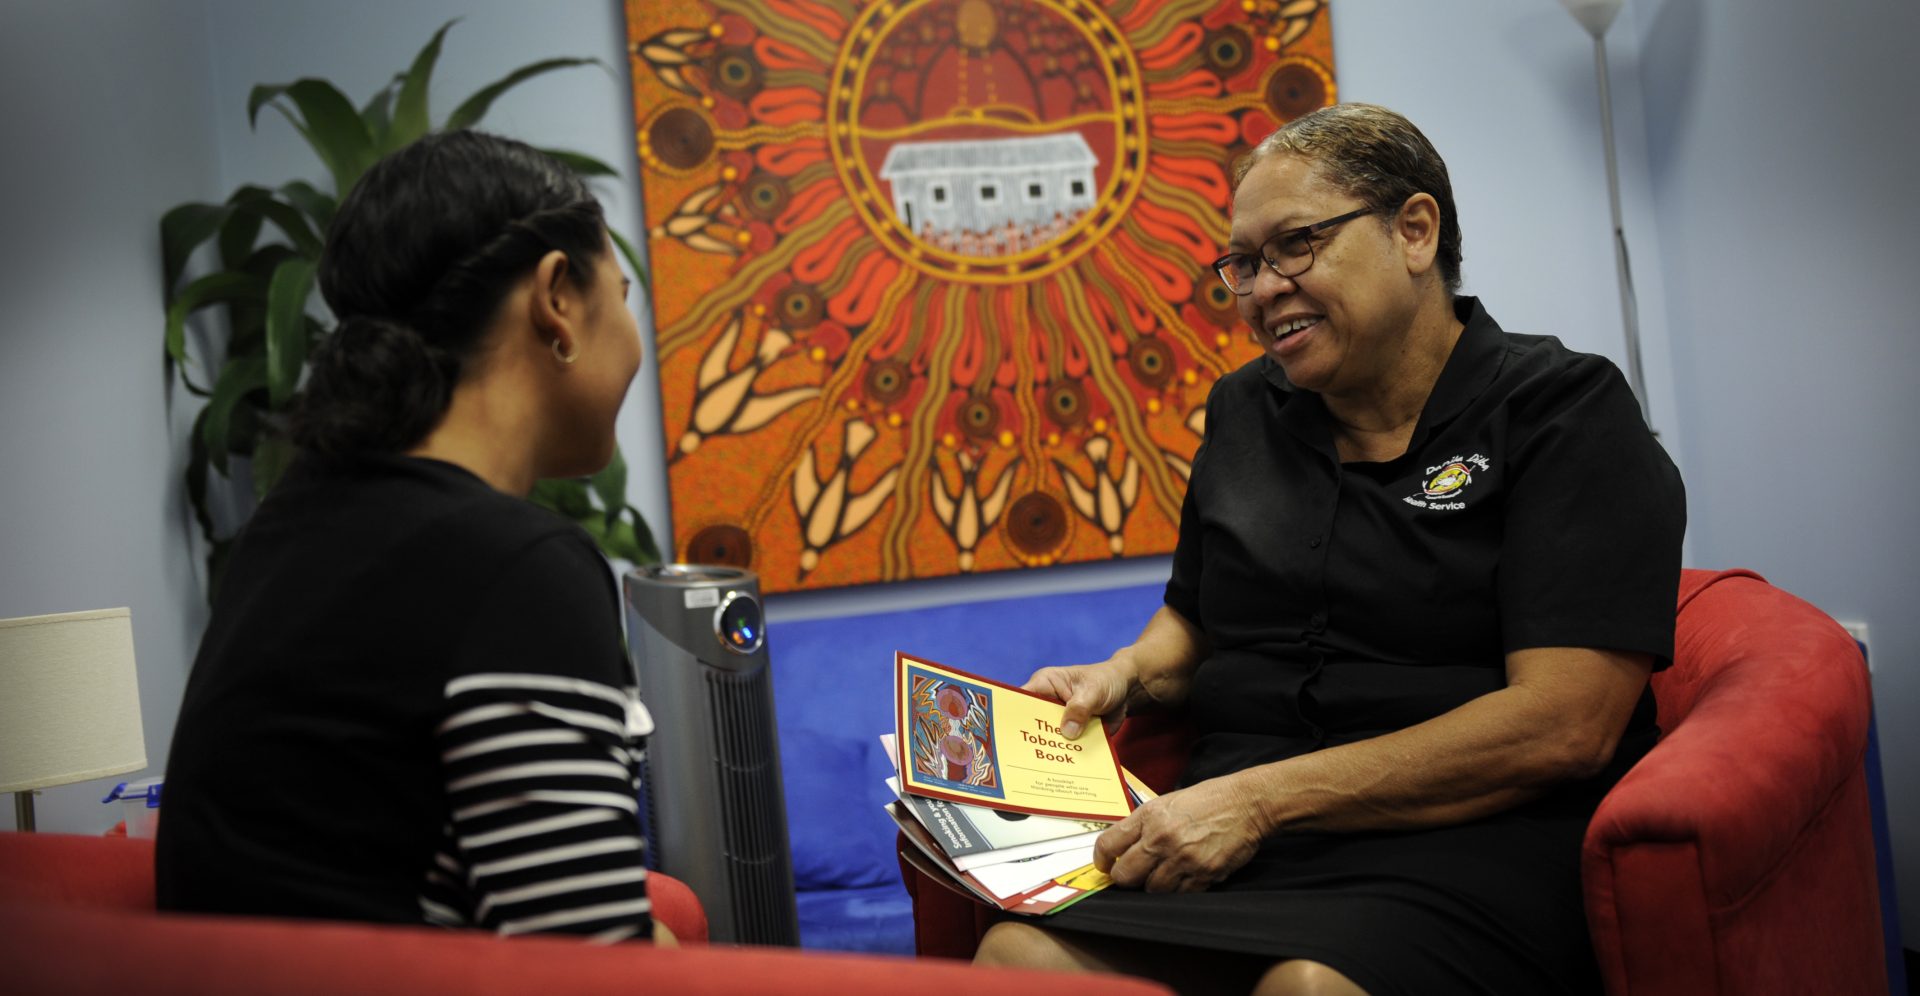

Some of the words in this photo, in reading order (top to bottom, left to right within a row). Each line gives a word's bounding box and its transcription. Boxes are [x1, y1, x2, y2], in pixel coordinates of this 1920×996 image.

[1428, 502, 1466, 510] Service
[1034, 718, 1063, 736] The
[1020, 730, 1083, 752] Tobacco
[1035, 749, 1076, 764] Book
[942, 807, 972, 848] Information
